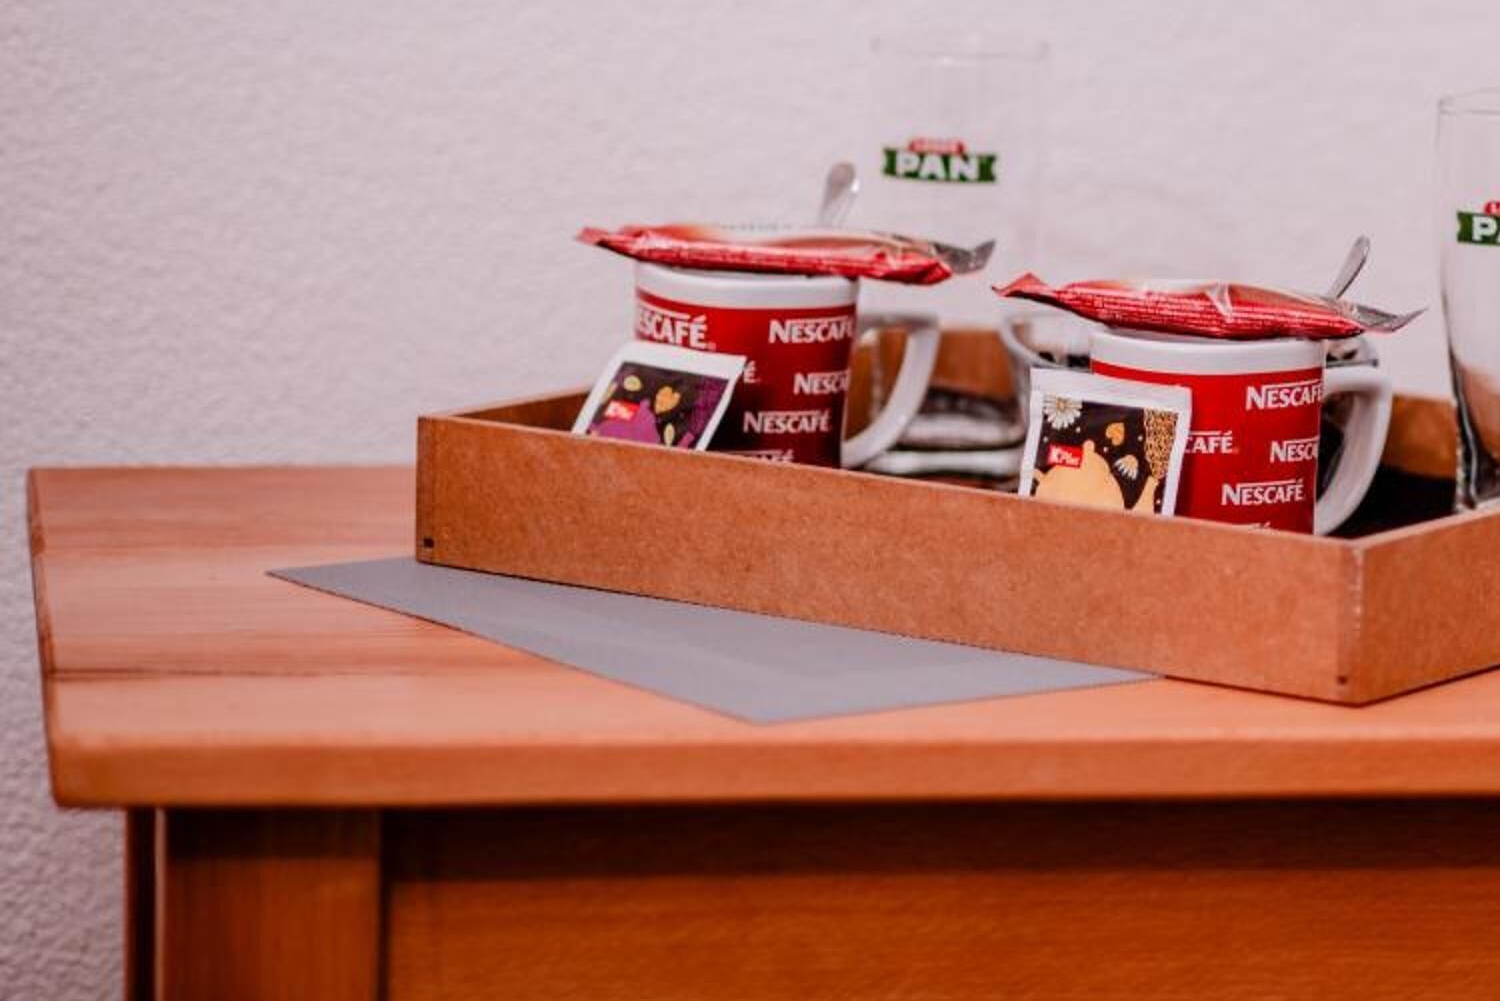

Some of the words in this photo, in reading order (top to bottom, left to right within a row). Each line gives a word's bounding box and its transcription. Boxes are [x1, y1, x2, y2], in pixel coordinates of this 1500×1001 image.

[897, 152, 977, 180] PAN
[743, 409, 830, 433] NESCAFÉ
[1221, 479, 1304, 506] NESCAFÉ
